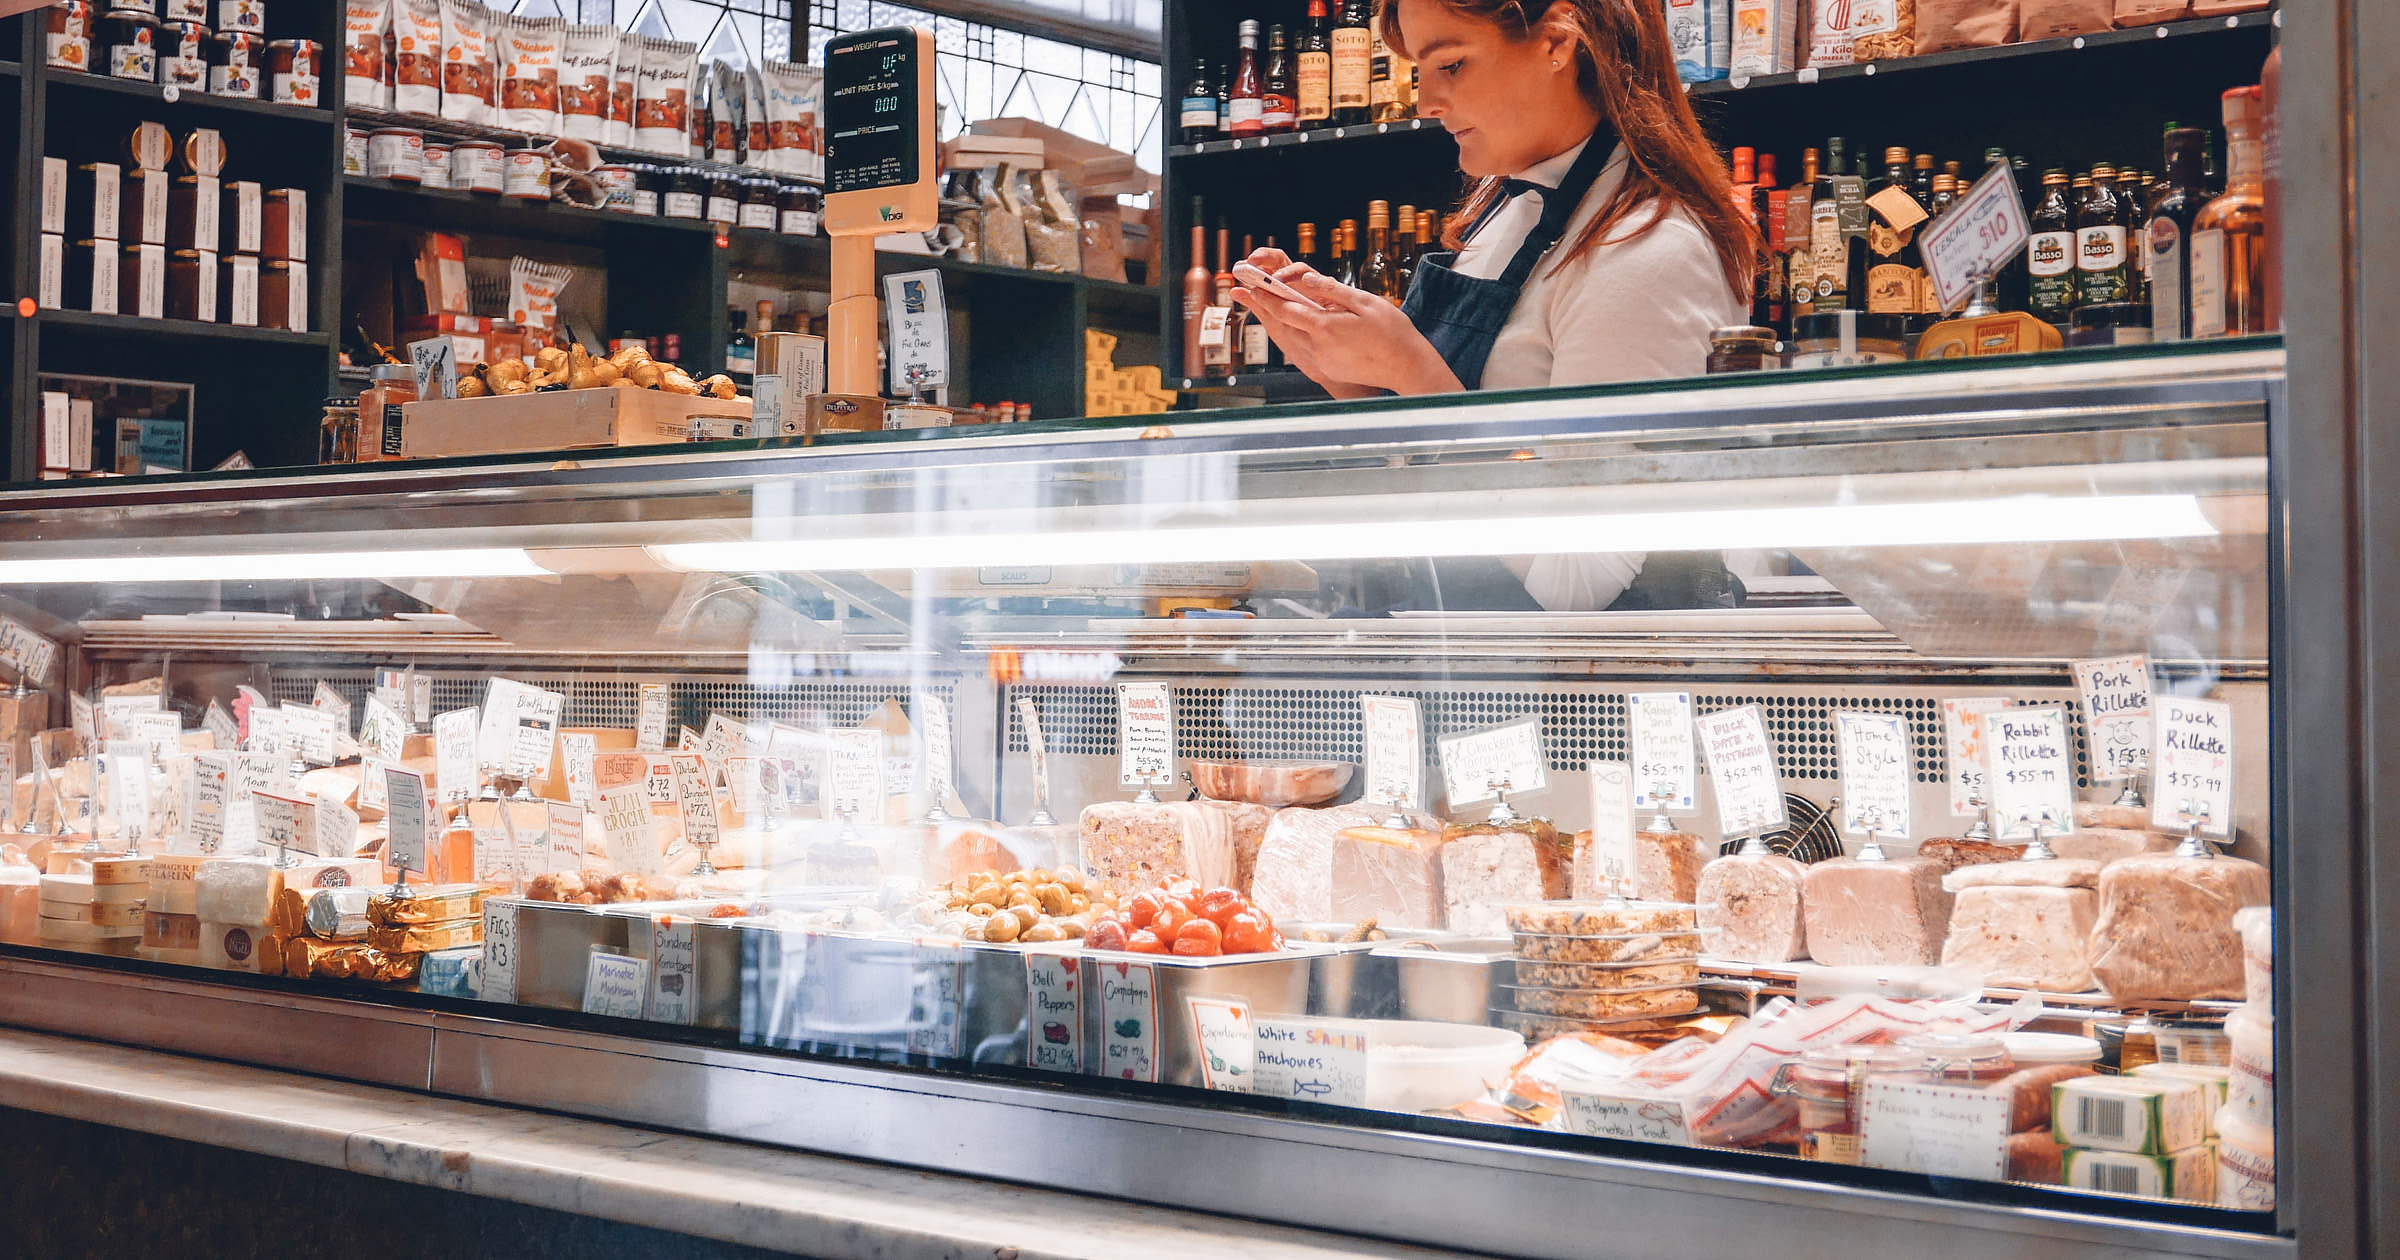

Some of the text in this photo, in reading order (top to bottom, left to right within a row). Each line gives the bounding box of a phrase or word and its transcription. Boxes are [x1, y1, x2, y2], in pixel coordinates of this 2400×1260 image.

[853, 40, 878, 52] WEIGHT
[1336, 35, 1366, 45] SOTO
[1832, 44, 1852, 54] Kilo
[841, 86, 856, 95] UNIT
[857, 84, 876, 93] PRICE
[857, 125, 877, 135] PRICE
[828, 145, 835, 158] $
[888, 212, 903, 221] DIGI
[1979, 212, 2009, 251] $10
[2035, 251, 2062, 261] Basso
[2085, 244, 2113, 255] Basso
[2092, 671, 2132, 690] Pork
[2091, 692, 2148, 717] Rillette
[1713, 718, 1748, 736] DUCK
[2170, 708, 2218, 728] Duck
[1642, 732, 1688, 746] Prune
[1854, 724, 1892, 742] Home
[2003, 723, 2051, 741] Rabbit
[2166, 730, 2227, 755] Rillette
[1856, 745, 1897, 772] Style
[2001, 744, 2060, 764] Rillette
[648, 776, 669, 791] $72
[2005, 769, 2055, 784] $55.99
[2168, 773, 2222, 792] $55.99
[490, 916, 510, 938] FIGS
[491, 943, 507, 967] $3
[1032, 968, 1055, 987] Bell
[1038, 991, 1075, 1015] Peppers
[1258, 1026, 1366, 1053] White SPANISH
[1109, 1045, 1128, 1058] $29
[1258, 1050, 1323, 1070] Anchovies
[1570, 1095, 1591, 1114] Mrs
[1585, 1119, 1671, 1140] Smoked Trout
